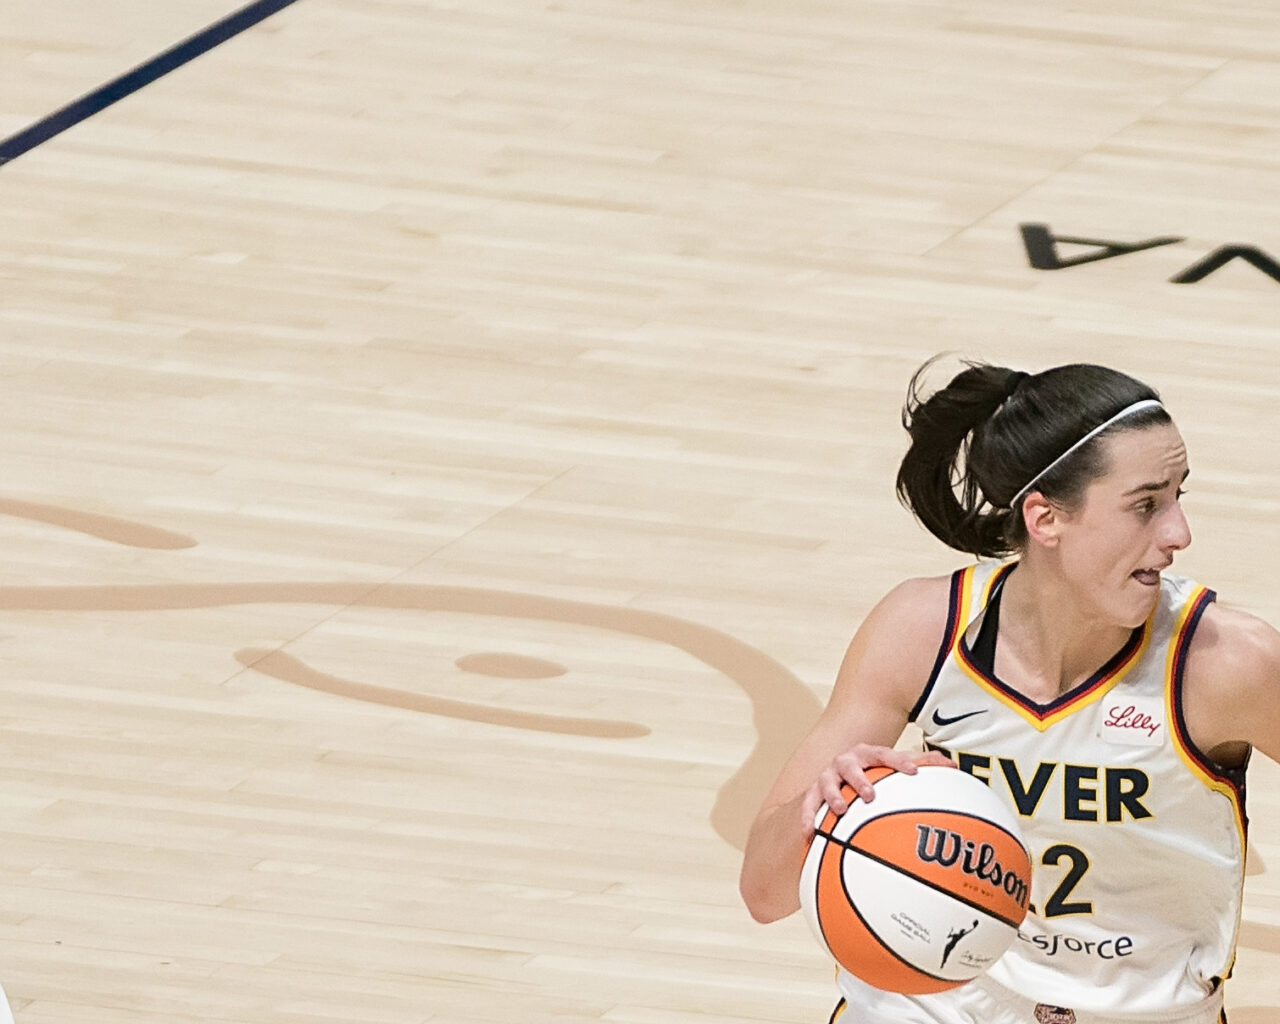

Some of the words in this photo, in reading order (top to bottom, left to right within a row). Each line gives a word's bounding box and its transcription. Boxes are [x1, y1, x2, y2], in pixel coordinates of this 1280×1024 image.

[1104, 705, 1161, 738] Lilly
[926, 742, 1154, 825] VER
[916, 824, 1028, 910] Wilson
[1027, 841, 1094, 919] 2
